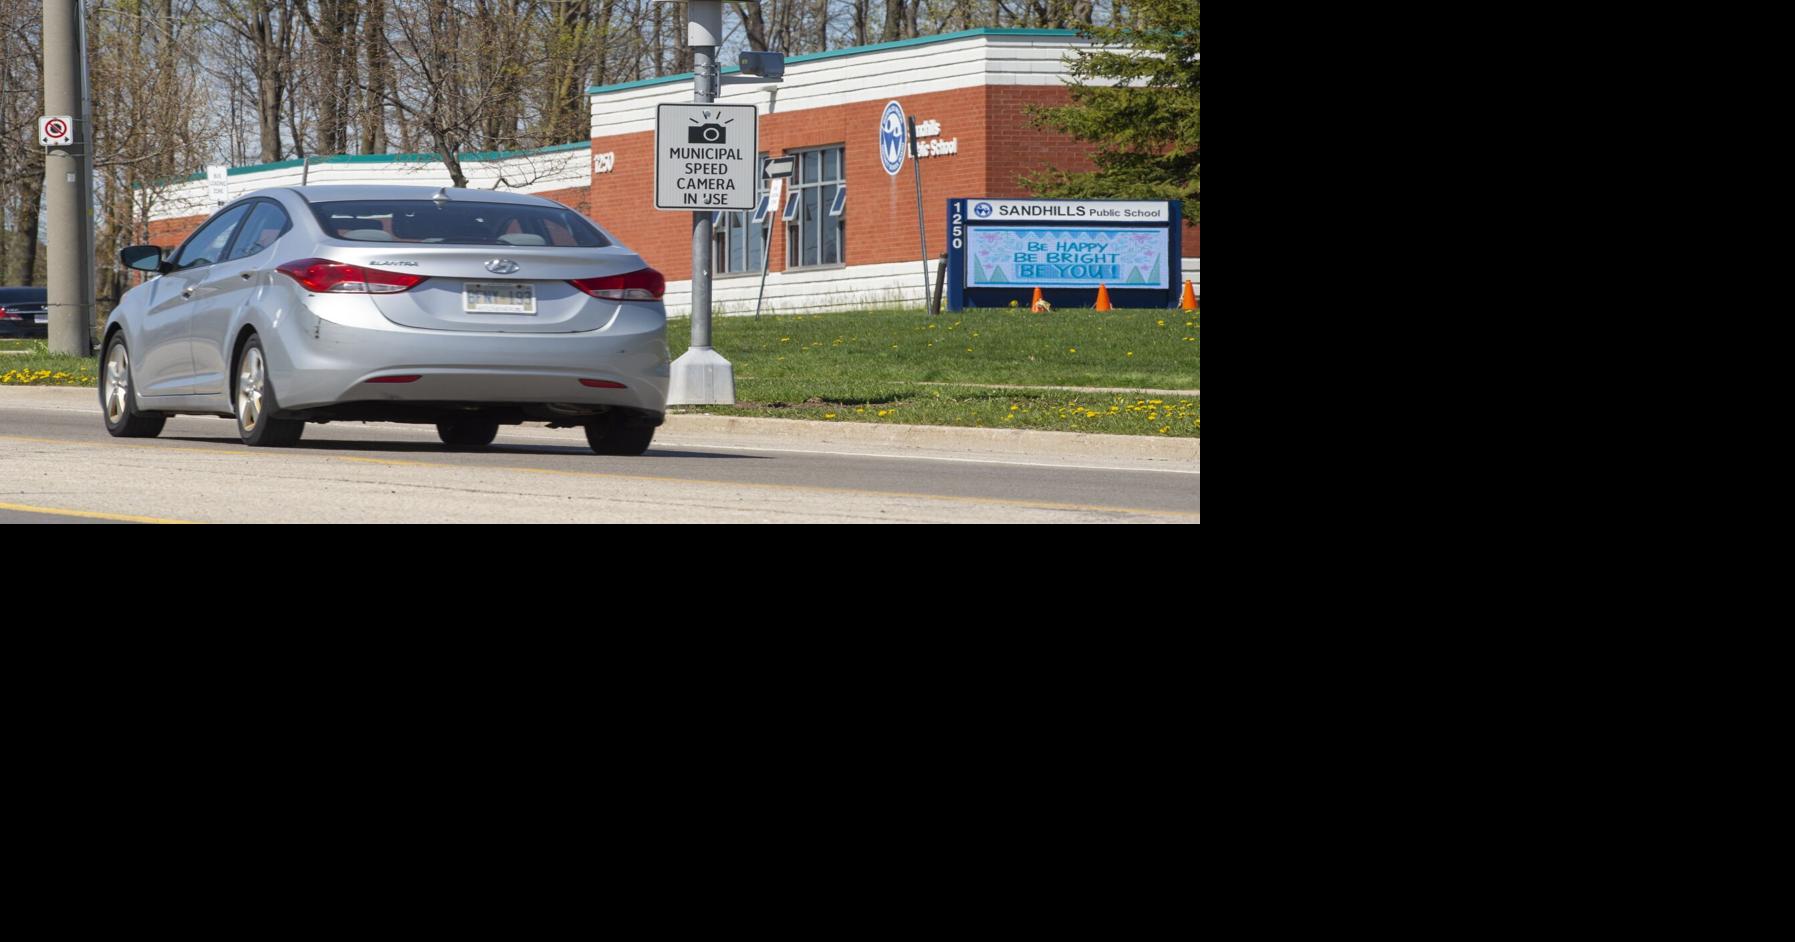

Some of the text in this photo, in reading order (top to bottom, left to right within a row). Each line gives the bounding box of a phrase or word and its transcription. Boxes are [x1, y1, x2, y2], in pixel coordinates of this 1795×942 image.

[669, 147, 743, 160] MUNICIPAL
[685, 162, 728, 175] SPEED
[676, 177, 736, 190] CAMERA
[683, 192, 728, 205] IN USE
[999, 204, 1161, 218] SANDHILLS Public School
[952, 201, 963, 249] 1250
[1056, 241, 1108, 253] HAPPY
[1014, 252, 1121, 264] BE BRIGHT
[1020, 264, 1046, 278] BE
